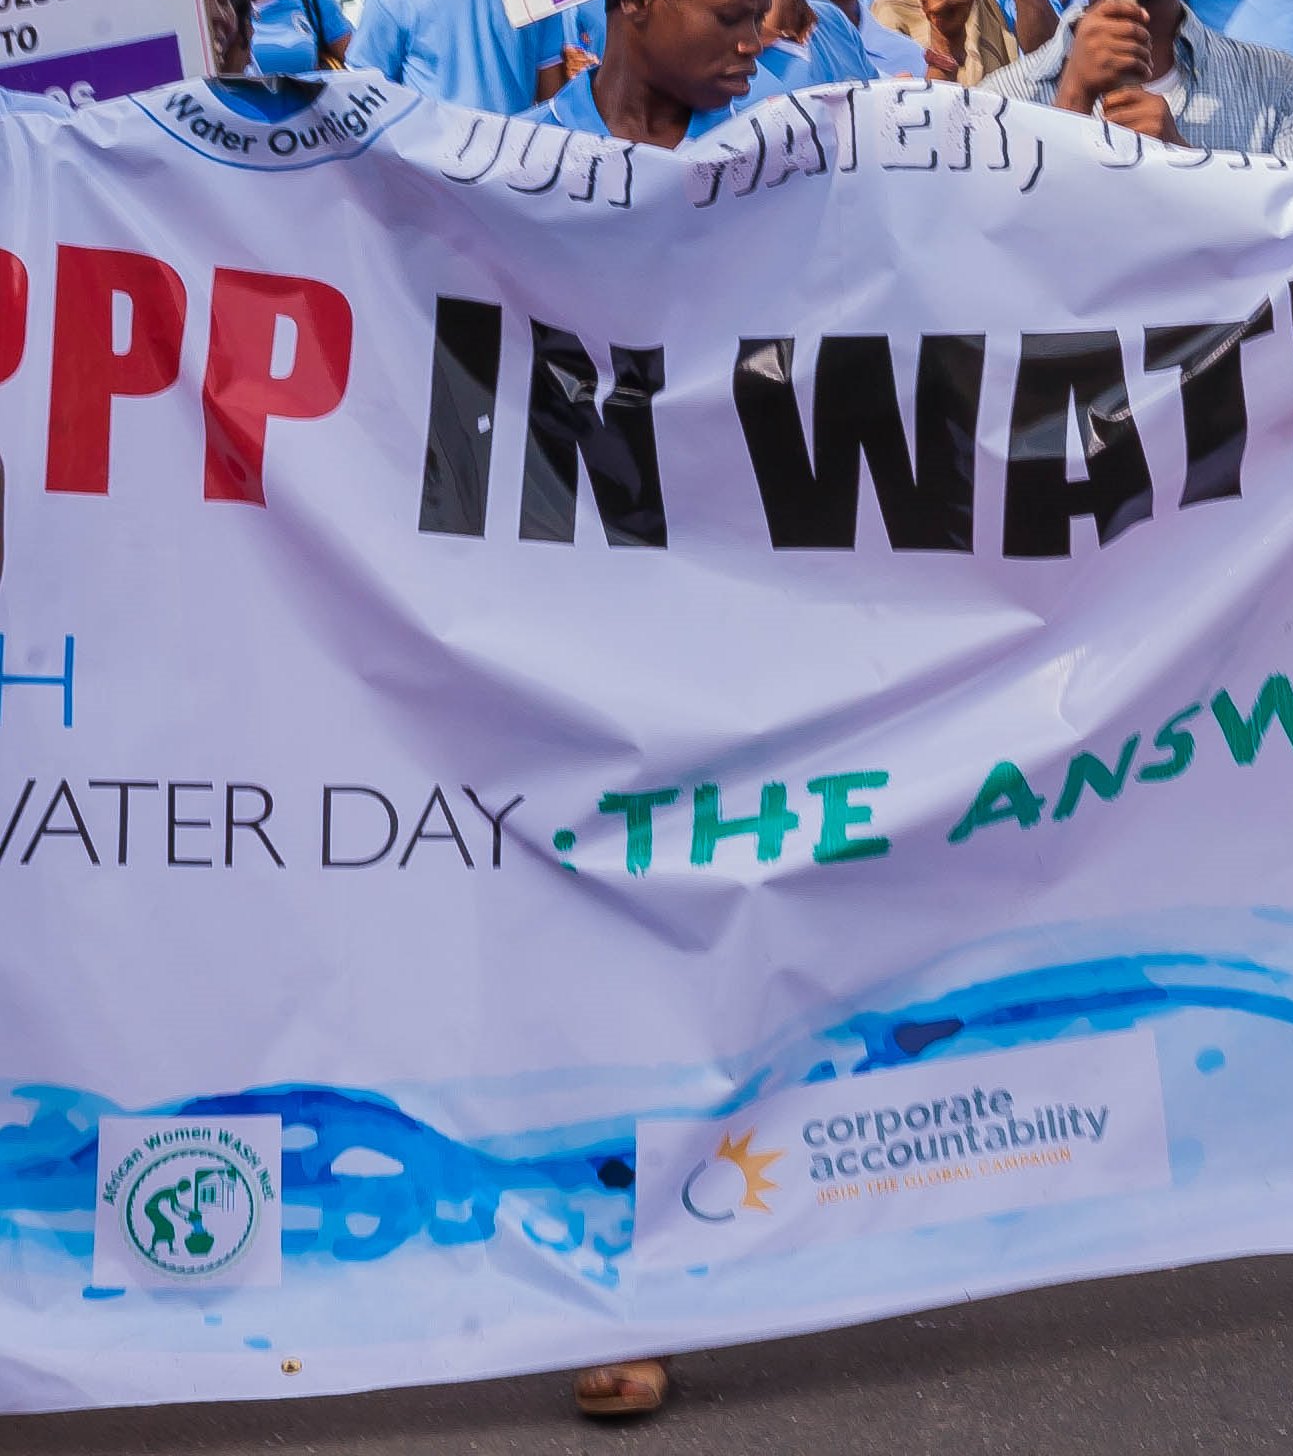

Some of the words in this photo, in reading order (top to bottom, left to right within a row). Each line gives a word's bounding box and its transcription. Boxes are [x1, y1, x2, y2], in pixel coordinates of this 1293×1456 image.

[1, 23, 38, 55] TO
[165, 92, 258, 154] Water
[417, 295, 669, 550] IN
[322, 782, 526, 871] DAY
[802, 1085, 1015, 1144] corporate
[808, 1104, 1110, 1182] accountability
[102, 1148, 143, 1206] African
[143, 1127, 212, 1151] Women
[218, 1128, 262, 1168] WASH
[816, 1187, 860, 1206] JOIN
[866, 1177, 899, 1196] THE
[904, 1166, 973, 1189] GLOBAL
[978, 1147, 1072, 1177] CAMPAIGN
